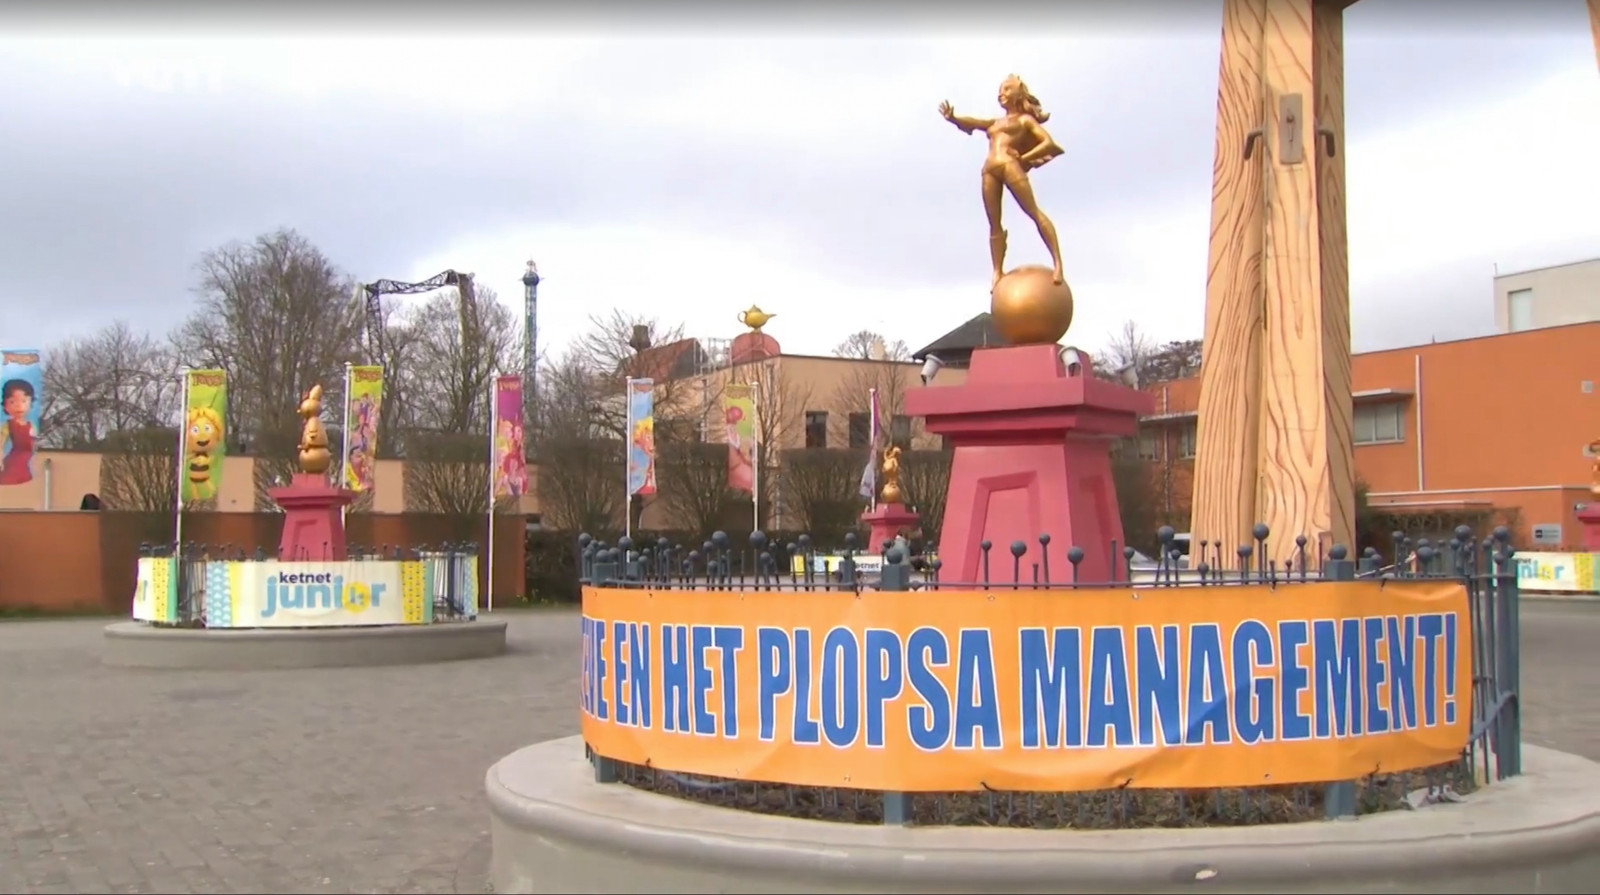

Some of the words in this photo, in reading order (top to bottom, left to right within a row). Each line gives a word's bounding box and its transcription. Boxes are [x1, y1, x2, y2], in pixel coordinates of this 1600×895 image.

[260, 574, 387, 618] junior
[279, 571, 332, 584] ketnet
[613, 620, 652, 730] EN
[661, 624, 744, 739] HET
[757, 626, 1004, 752] PLOPSA
[1018, 611, 1458, 750] MANAGEMENT!
